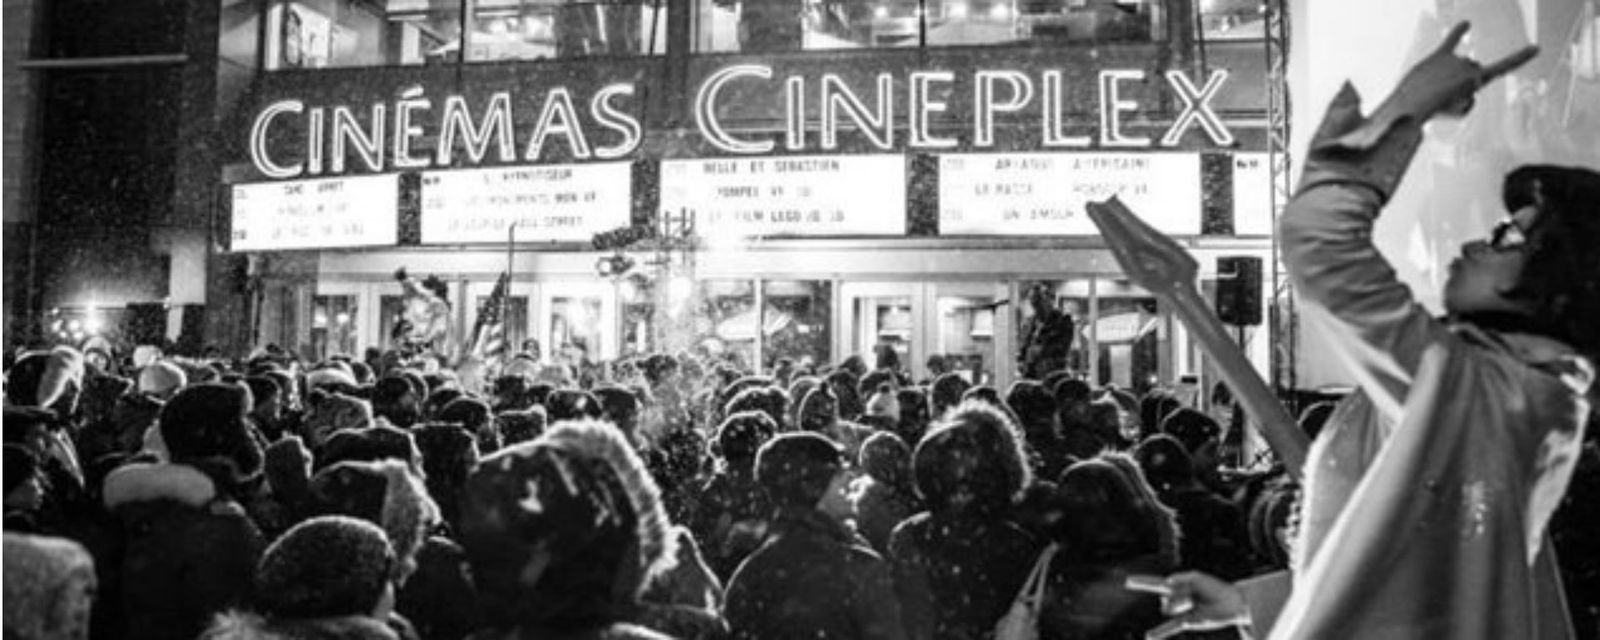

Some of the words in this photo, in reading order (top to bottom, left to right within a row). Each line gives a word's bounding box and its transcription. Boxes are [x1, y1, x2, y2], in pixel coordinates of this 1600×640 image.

[250, 83, 642, 178] CINÉMAS
[694, 63, 1236, 153] CINEPLEX
[750, 160, 766, 173] ET
